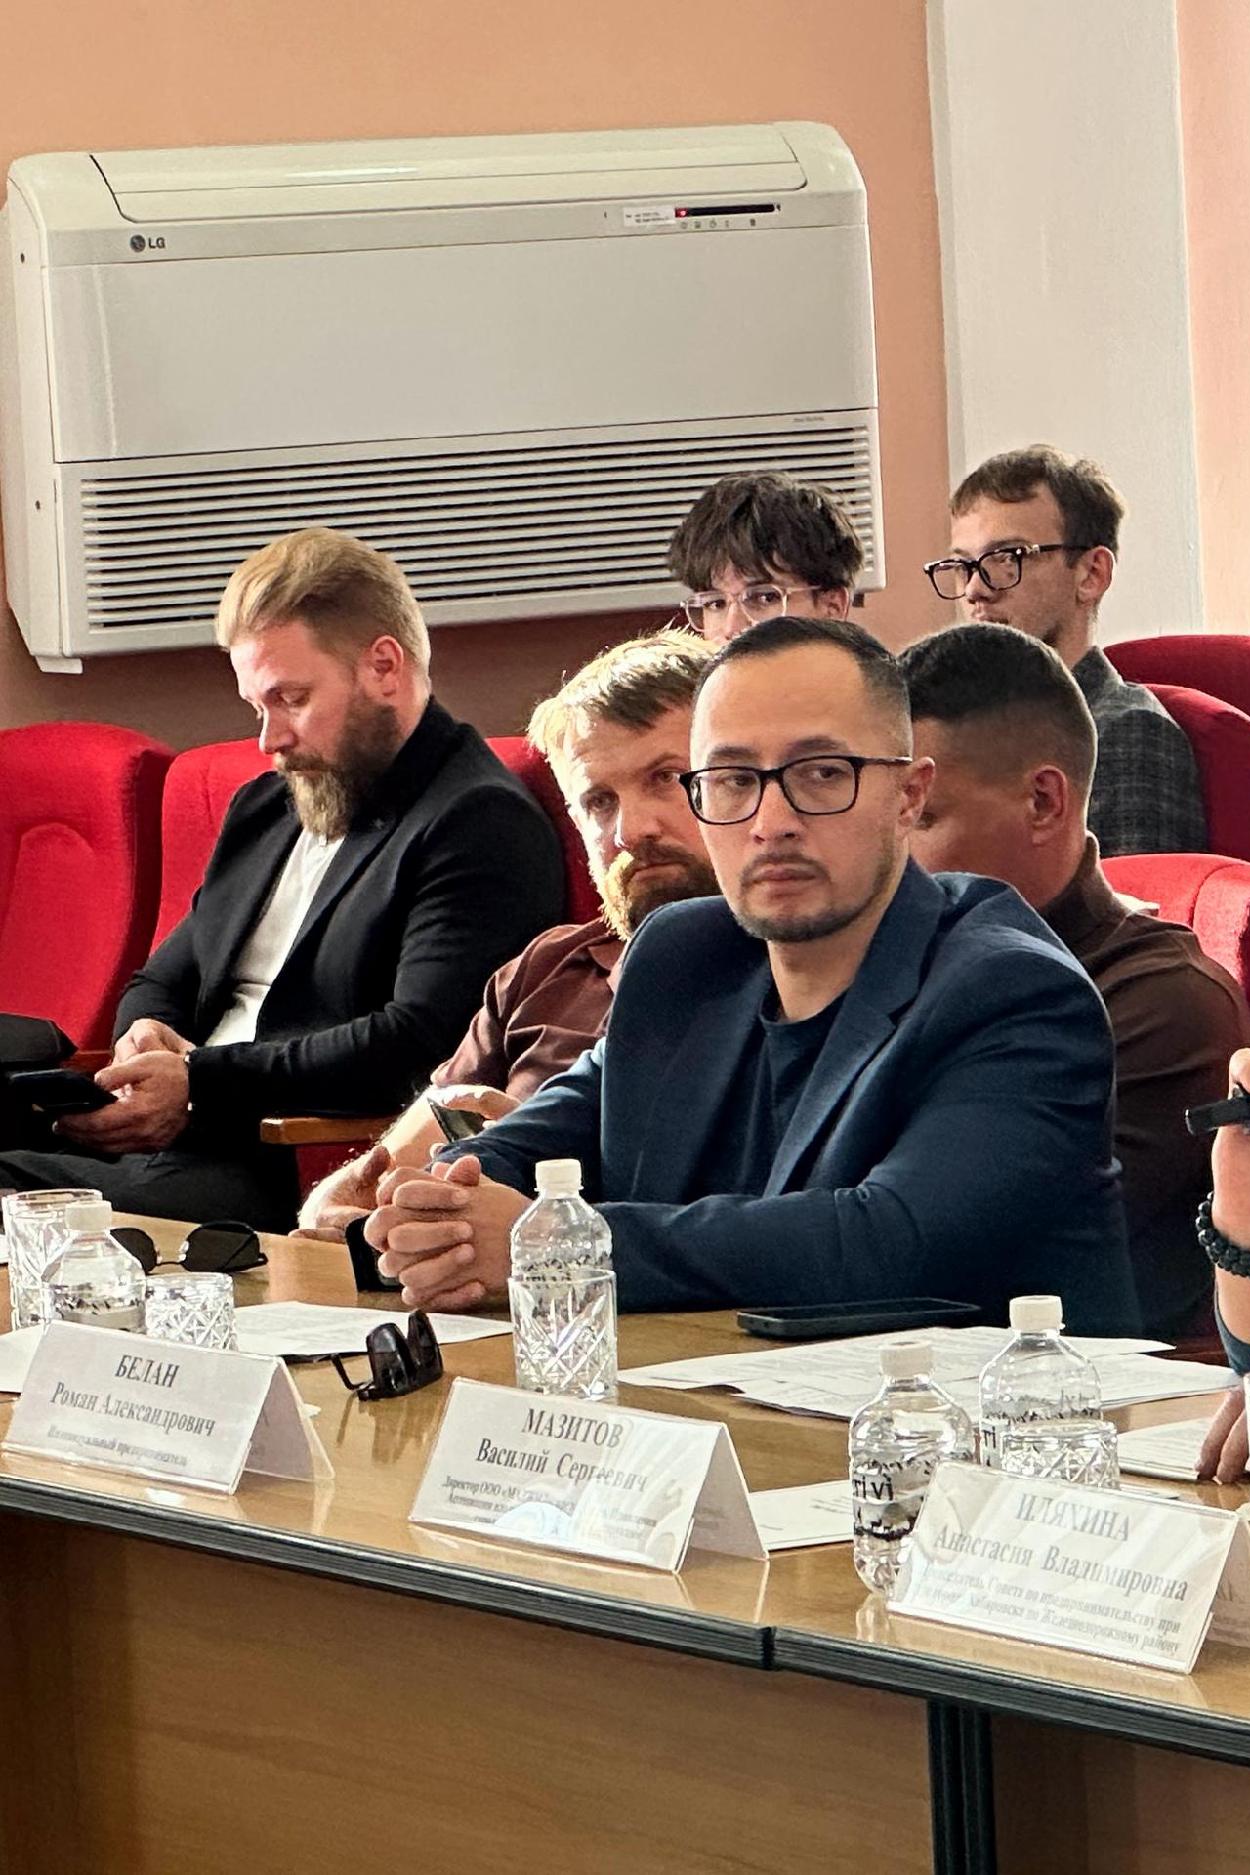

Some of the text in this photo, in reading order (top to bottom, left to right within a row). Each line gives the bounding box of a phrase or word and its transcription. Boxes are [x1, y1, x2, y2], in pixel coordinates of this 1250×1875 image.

[148, 236, 165, 249] LG
[115, 1354, 180, 1388] БЕЛАН
[50, 1382, 216, 1437] Роман Александрович
[521, 1408, 624, 1449] МАЗИТОВ
[476, 1438, 648, 1492] Василий Сергеевич
[934, 1524, 1188, 1601] Анастасия Владимировна
